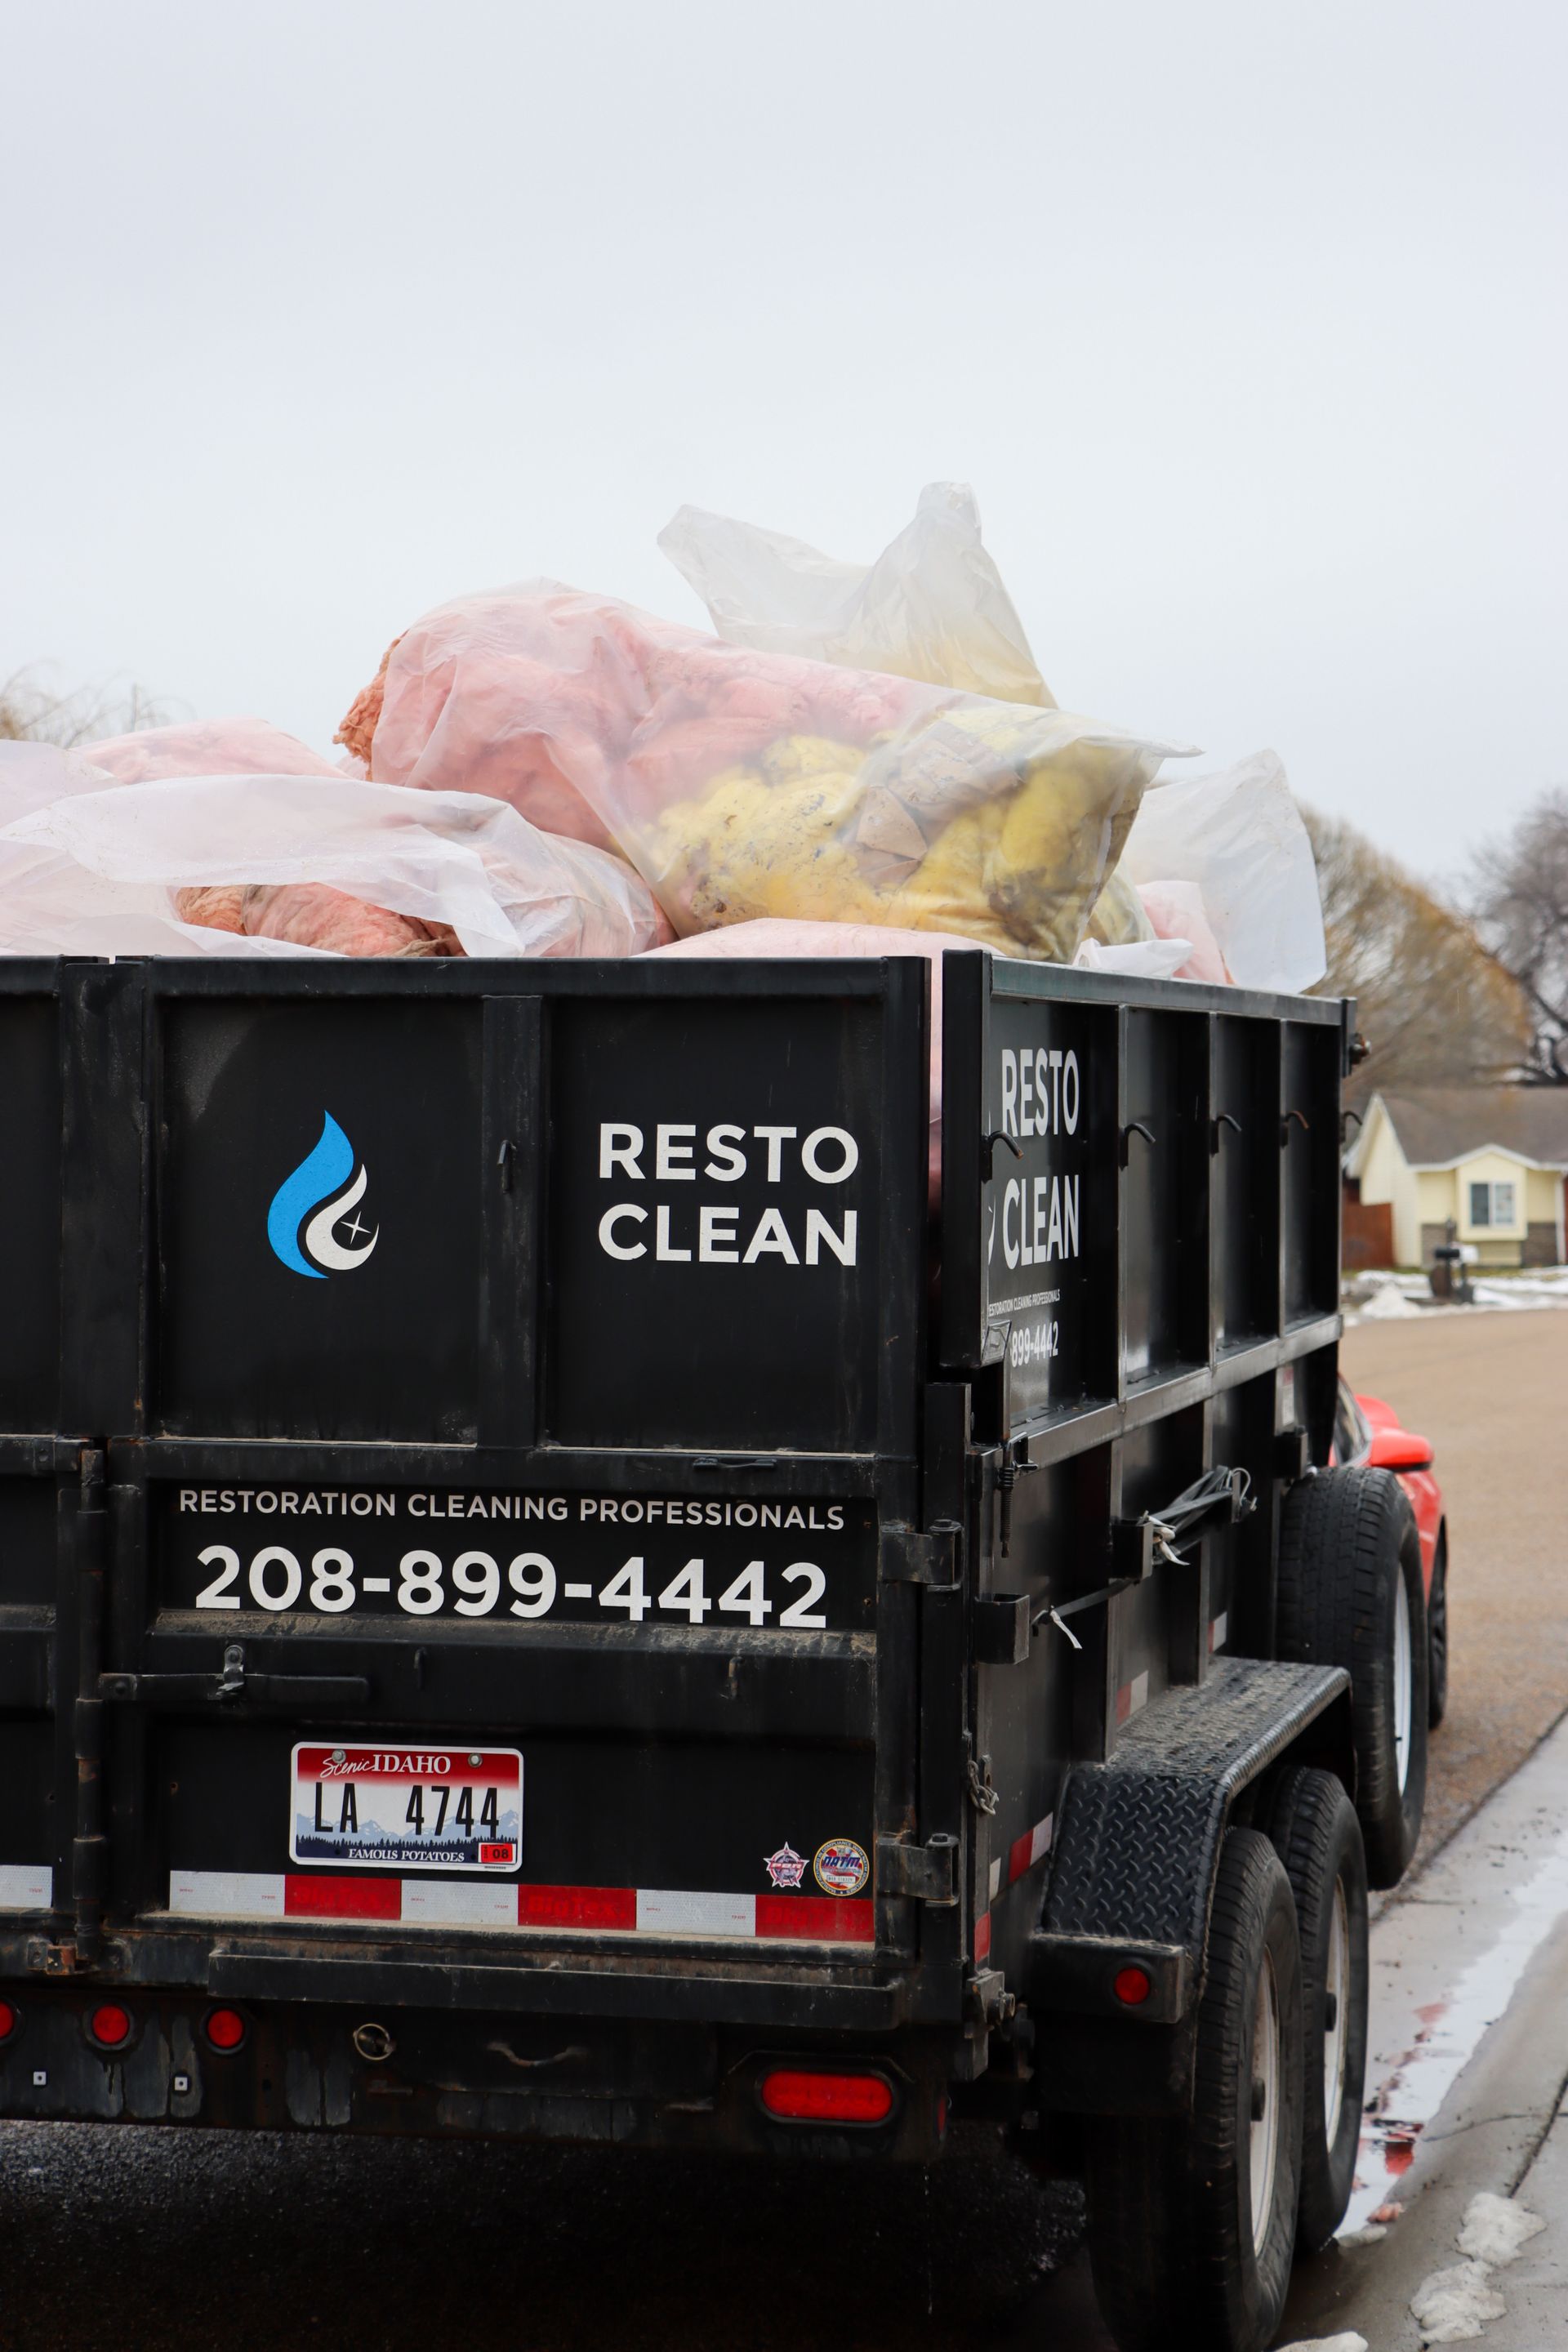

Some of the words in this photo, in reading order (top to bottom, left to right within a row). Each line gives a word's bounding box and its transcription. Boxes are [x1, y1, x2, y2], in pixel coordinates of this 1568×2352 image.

[1001, 1048, 1079, 1138] RESTO
[599, 1123, 859, 1184] RESTO
[599, 1203, 858, 1267] CLEAN
[1003, 1174, 1079, 1270] CLEAN
[987, 1299, 1013, 1316] ESTORATION
[1013, 1294, 1032, 1311] CLEANING
[1031, 1289, 1060, 1307] PROFESSIONALS
[180, 1490, 396, 1517] RESTORATION
[407, 1494, 569, 1521] CLEANING
[580, 1499, 845, 1530] PROFESSIONALS
[195, 1544, 827, 1628] 208-899-4442
[319, 1757, 374, 1778] Scenic
[372, 1753, 451, 1774] IDAHO
[314, 1781, 358, 1833] LA
[406, 1784, 499, 1838] 4744
[348, 1848, 399, 1860] FAMOUS
[401, 1850, 466, 1863] POTATOES
[492, 1848, 509, 1860] 08
